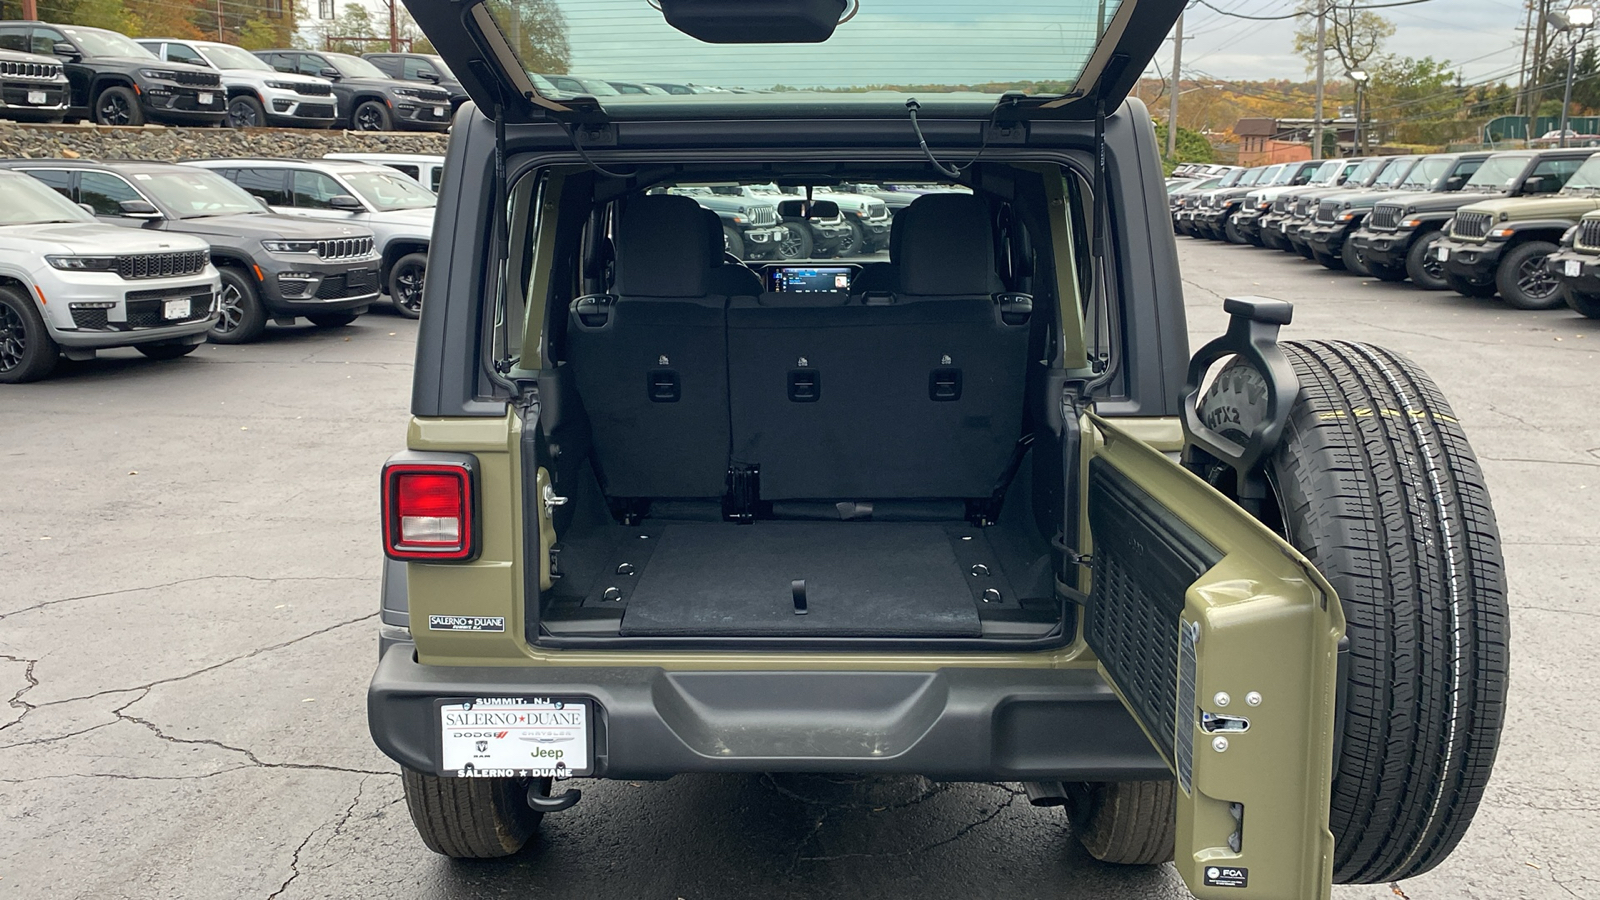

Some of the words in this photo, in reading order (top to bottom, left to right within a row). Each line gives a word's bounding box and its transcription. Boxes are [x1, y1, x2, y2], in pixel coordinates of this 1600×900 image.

[431, 617, 467, 625] SALERNO
[474, 619, 502, 627] DUANE
[446, 713, 518, 726] SALERNO
[527, 713, 581, 726] DUANE
[531, 747, 564, 760] Jeep
[457, 769, 514, 777] SALERNO
[532, 769, 573, 777] DUANE
[1222, 869, 1243, 877] FCA
